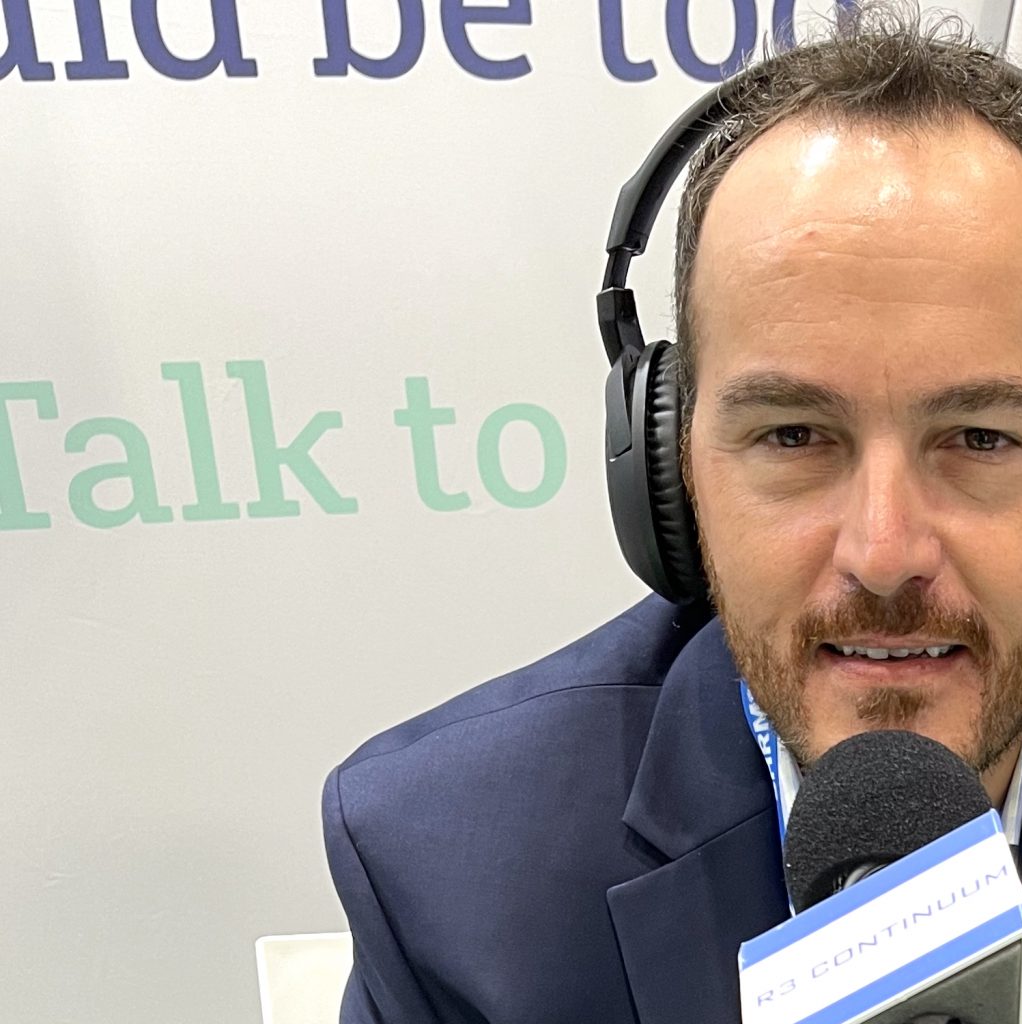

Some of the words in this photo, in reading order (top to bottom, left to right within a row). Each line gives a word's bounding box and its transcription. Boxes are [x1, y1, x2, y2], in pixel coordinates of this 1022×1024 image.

[393, 375, 567, 512] to
[757, 979, 797, 1007] R3
[811, 865, 1008, 979] CONTINUUM
